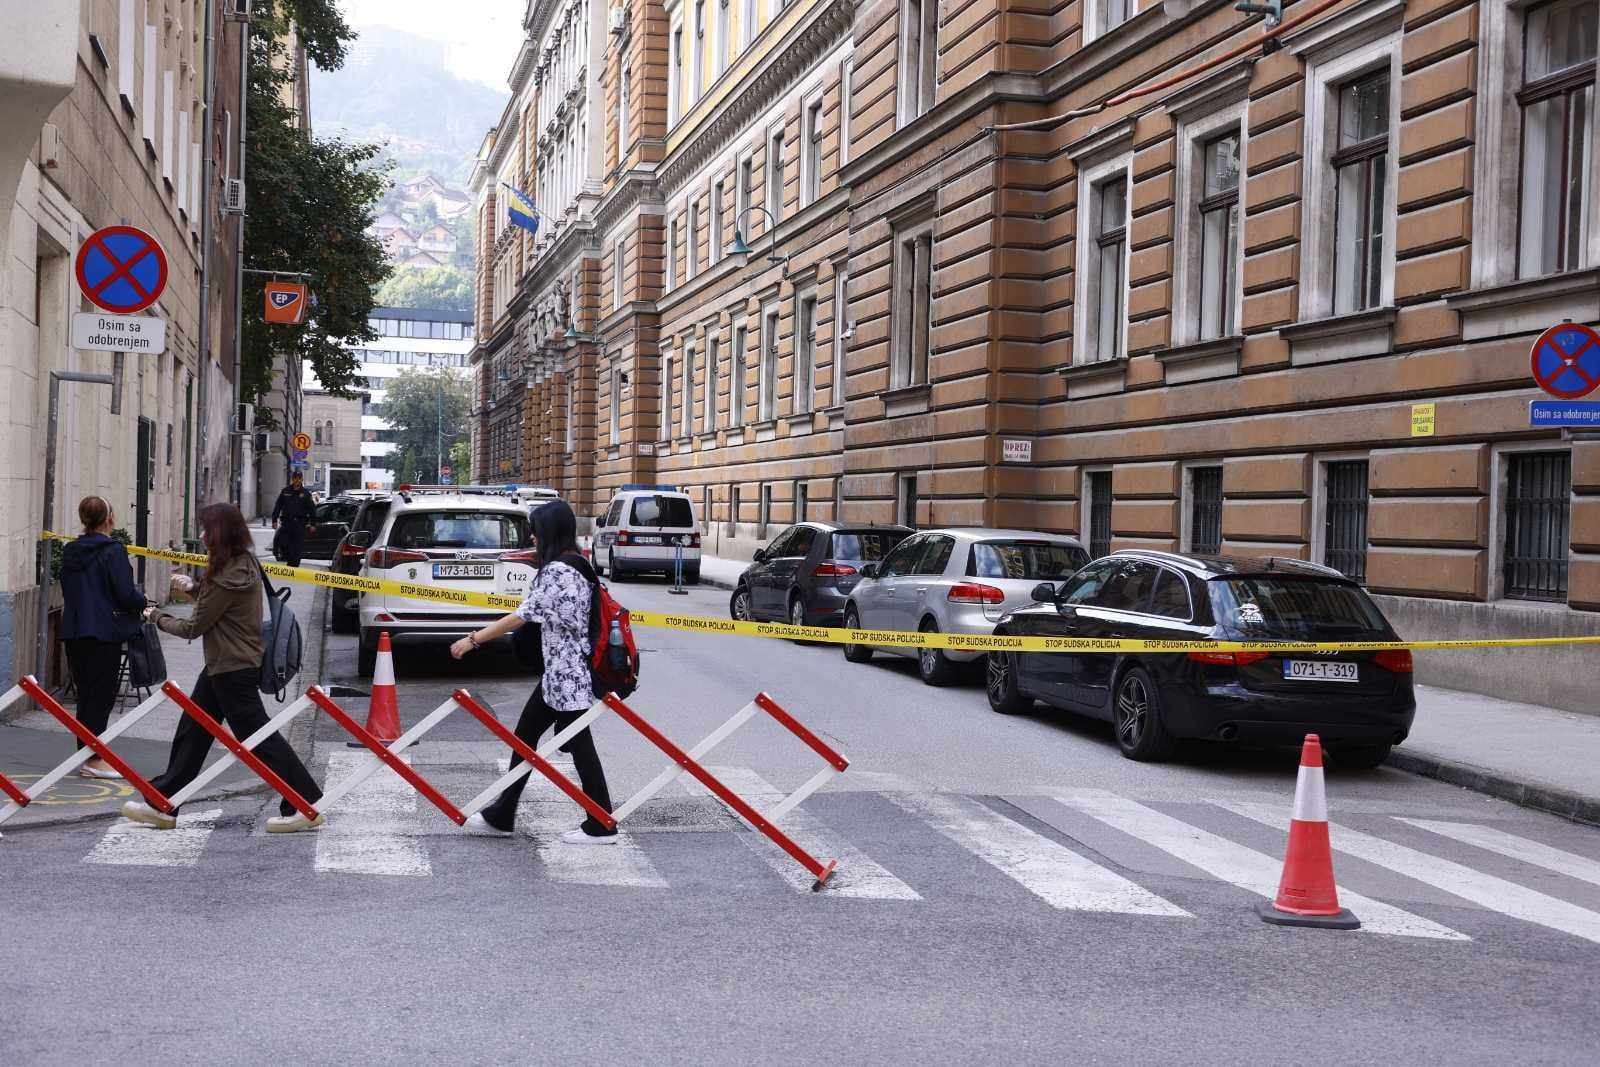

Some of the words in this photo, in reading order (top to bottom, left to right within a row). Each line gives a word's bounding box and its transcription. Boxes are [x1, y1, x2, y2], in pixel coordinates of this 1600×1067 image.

[276, 294, 288, 303] EP
[98, 318, 125, 331] Osim
[129, 322, 141, 332] sa
[88, 334, 149, 349] odobrenjem
[1534, 408, 1551, 419] Osim
[1552, 410, 1562, 419] sa
[270, 566, 295, 577] POLICIJA
[440, 565, 492, 576] M73-A-805
[314, 573, 329, 583] STOP
[330, 575, 354, 586] SUDSKA
[354, 578, 381, 590] POLICIJA
[513, 573, 527, 582] 122
[400, 585, 416, 595] STOP
[416, 587, 440, 598] SUDSKA
[440, 591, 467, 602] POLICIJA
[487, 597, 502, 606] STOP
[503, 599, 520, 608] SUDS
[665, 617, 682, 626] STOP
[682, 618, 707, 628] SUDSKA
[708, 621, 736, 631] POLICIJA
[757, 625, 774, 634] STOP
[775, 627, 800, 636] SUDSKA
[801, 629, 829, 638] POLICIJA
[851, 632, 868, 641] STOP
[869, 633, 895, 642] SUDSKA
[896, 634, 925, 643] POLICIJA
[947, 636, 965, 646] STOP
[966, 637, 993, 646] SUDSKA
[993, 638, 1023, 647] POLICIJA
[1045, 639, 1062, 648] STOP
[1063, 640, 1090, 648] SUDSKA
[1091, 640, 1121, 648] POLICIJA
[1143, 640, 1161, 648] STOP
[1161, 641, 1189, 649] SUDSKA
[1189, 641, 1219, 649] POLICIJA
[1293, 662, 1355, 677] 071-T-319
